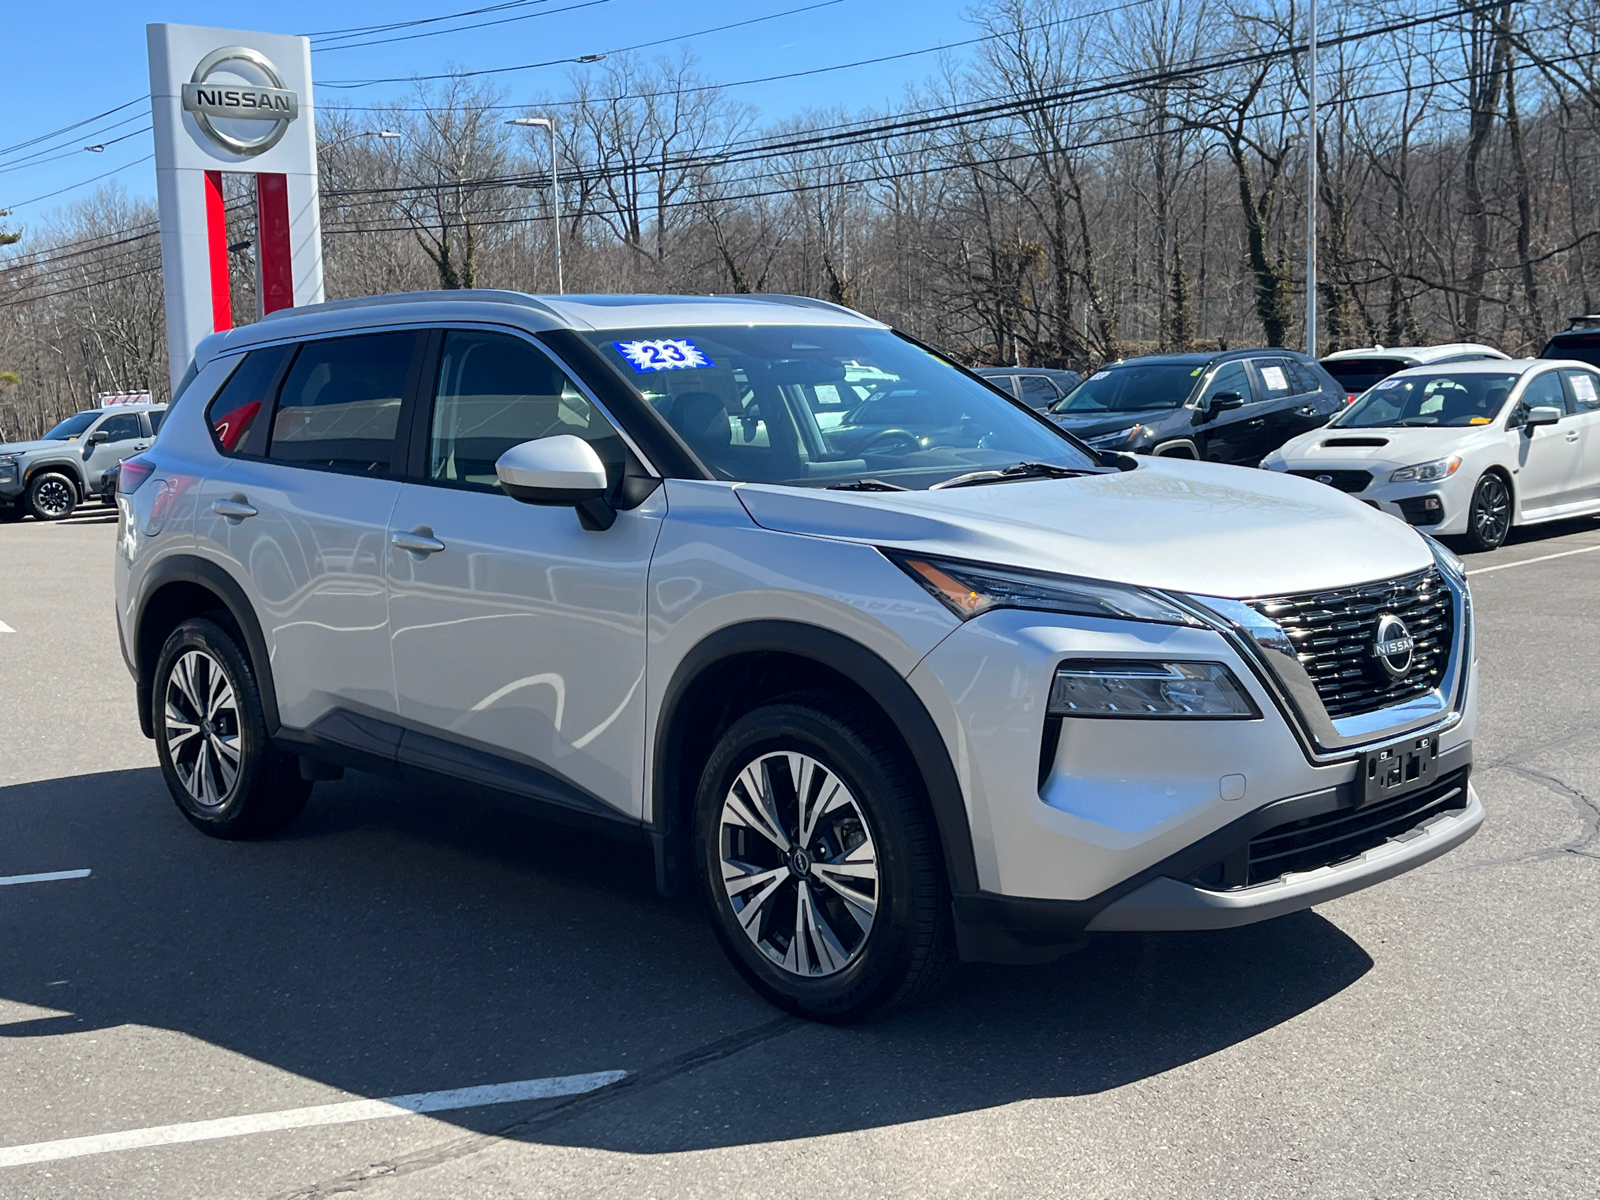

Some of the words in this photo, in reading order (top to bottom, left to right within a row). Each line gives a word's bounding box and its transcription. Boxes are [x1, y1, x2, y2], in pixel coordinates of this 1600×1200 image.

[196, 89, 290, 112] NISSAN
[641, 344, 686, 364] 23
[1376, 638, 1414, 655] NISSAN
